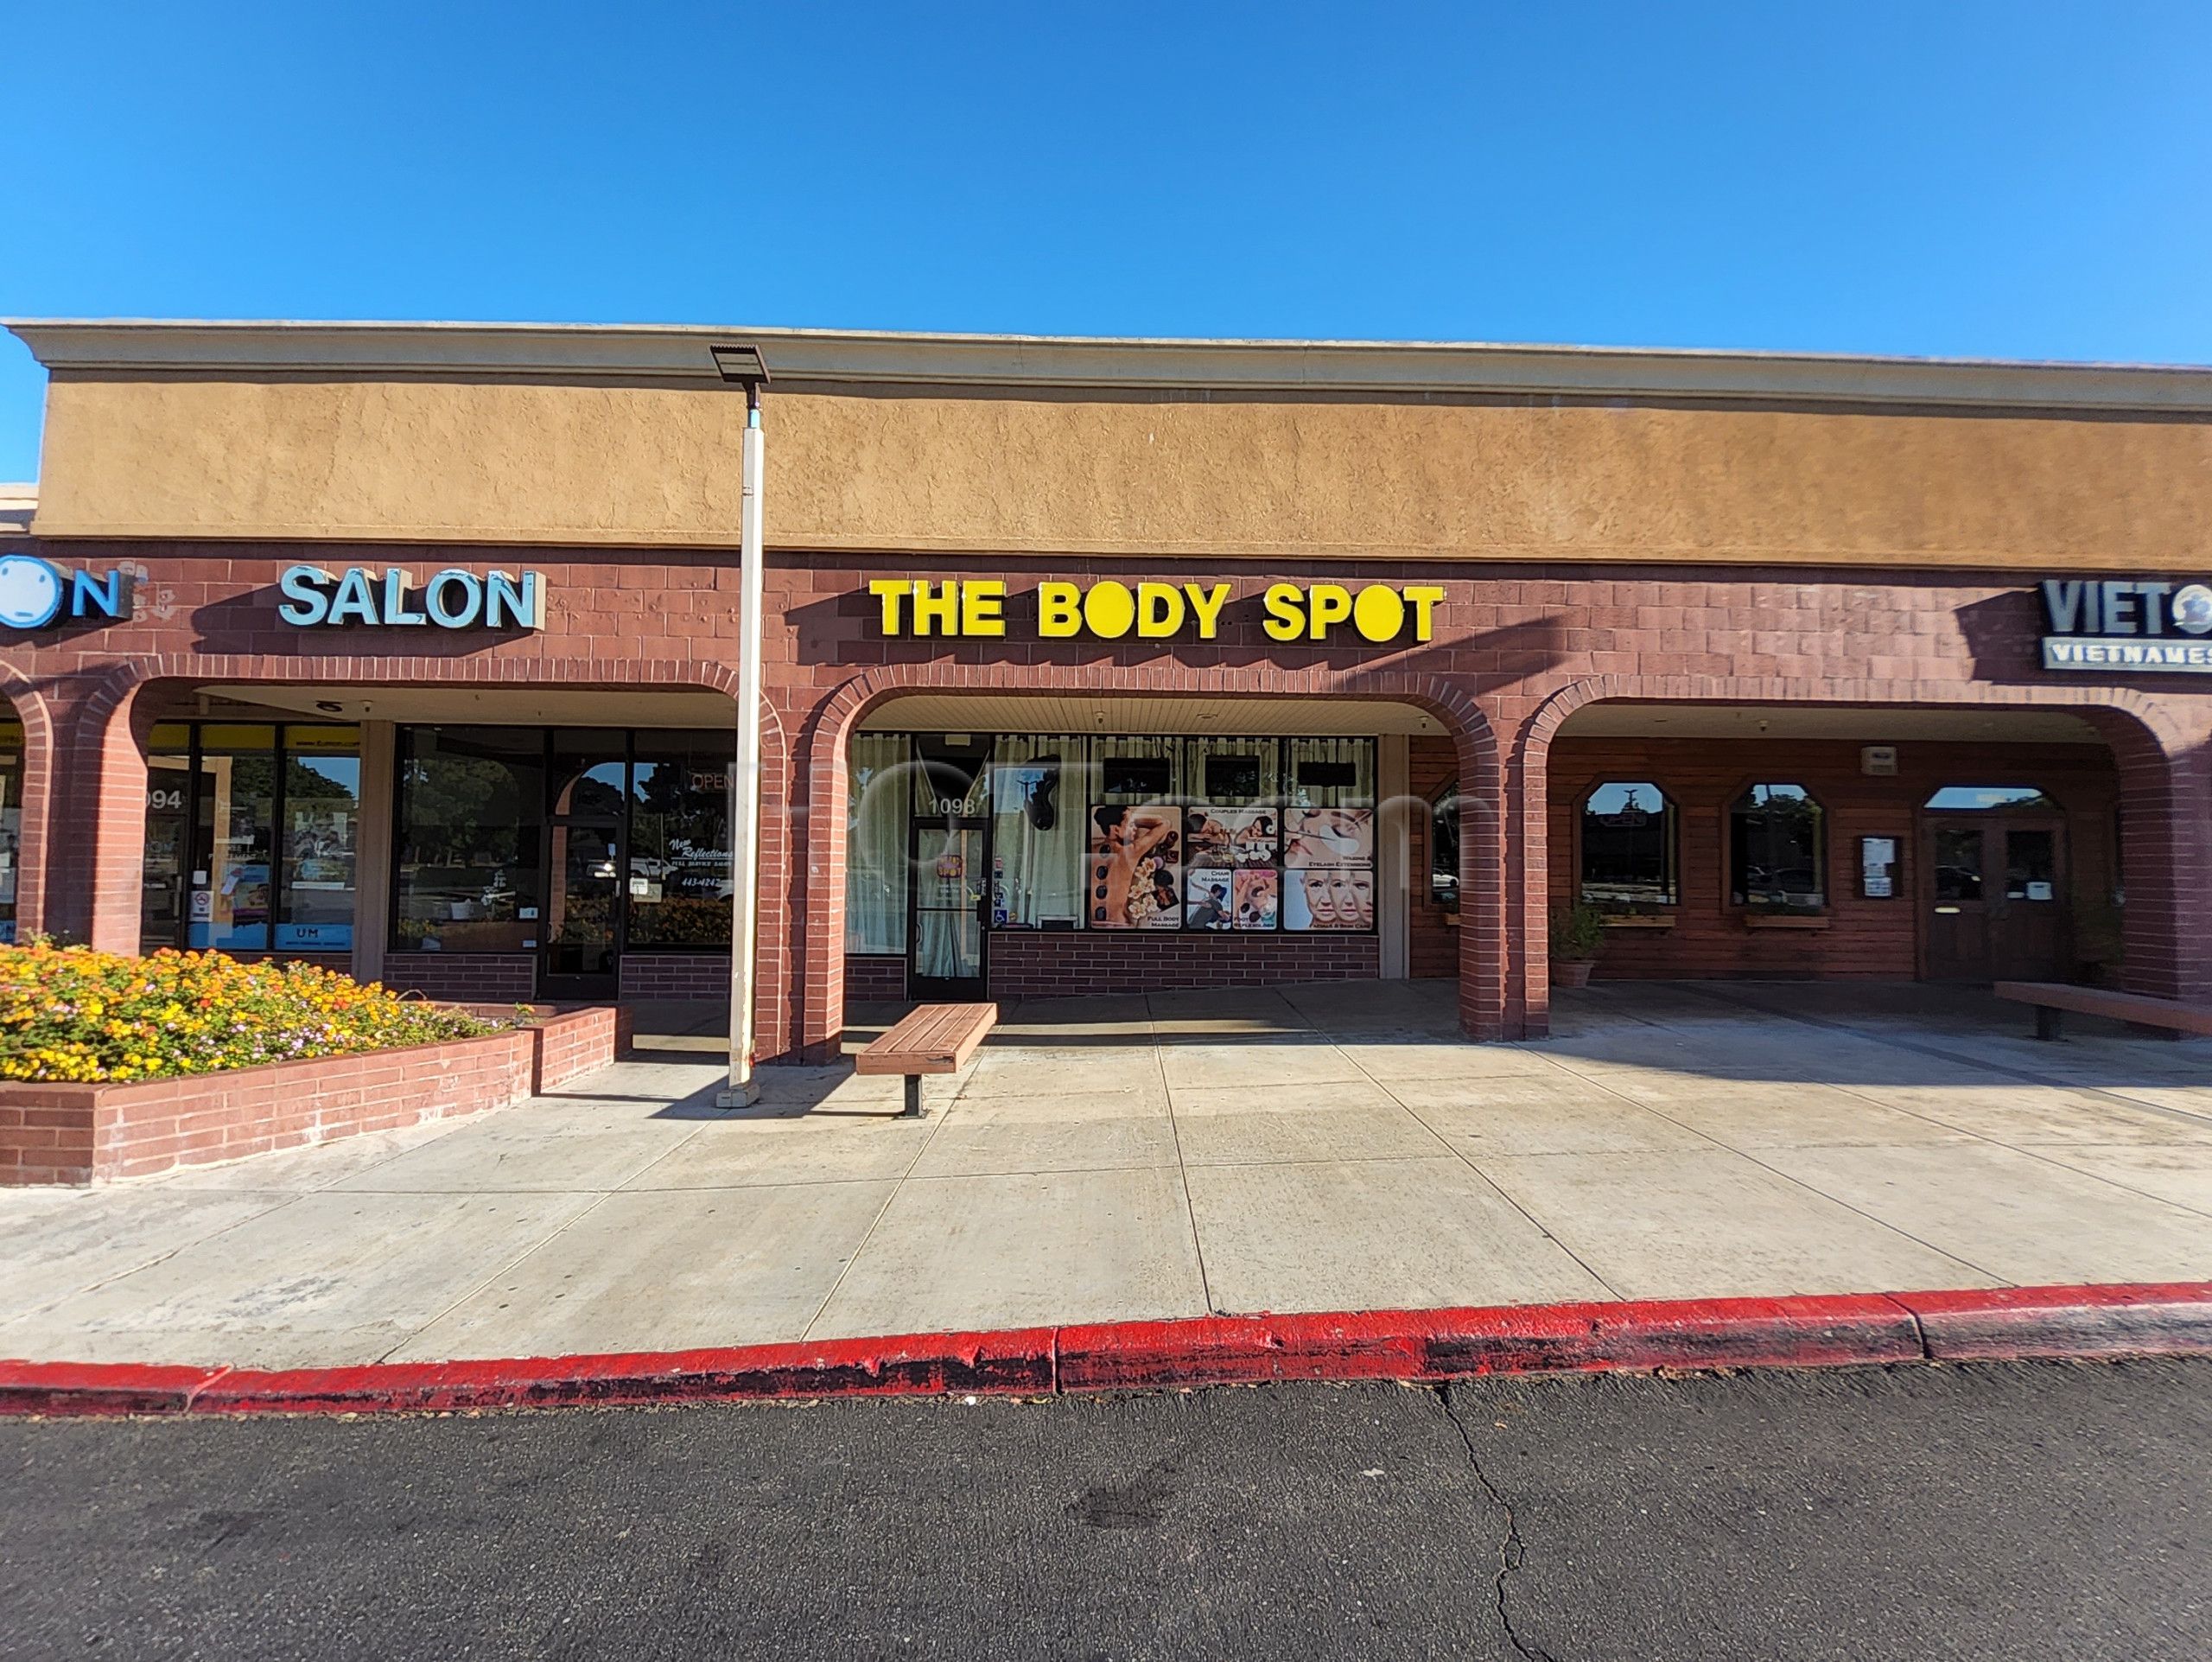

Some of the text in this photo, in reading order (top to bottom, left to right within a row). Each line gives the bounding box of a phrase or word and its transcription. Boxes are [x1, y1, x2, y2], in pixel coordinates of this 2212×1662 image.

[278, 564, 543, 629] SALON
[869, 580, 1446, 642] THE BODY SPOT
[2052, 643, 2212, 665] VIETNAME
[691, 774, 734, 789] OPEN
[929, 798, 976, 814] 1098
[668, 838, 691, 850] New
[682, 846, 734, 860] Reflections
